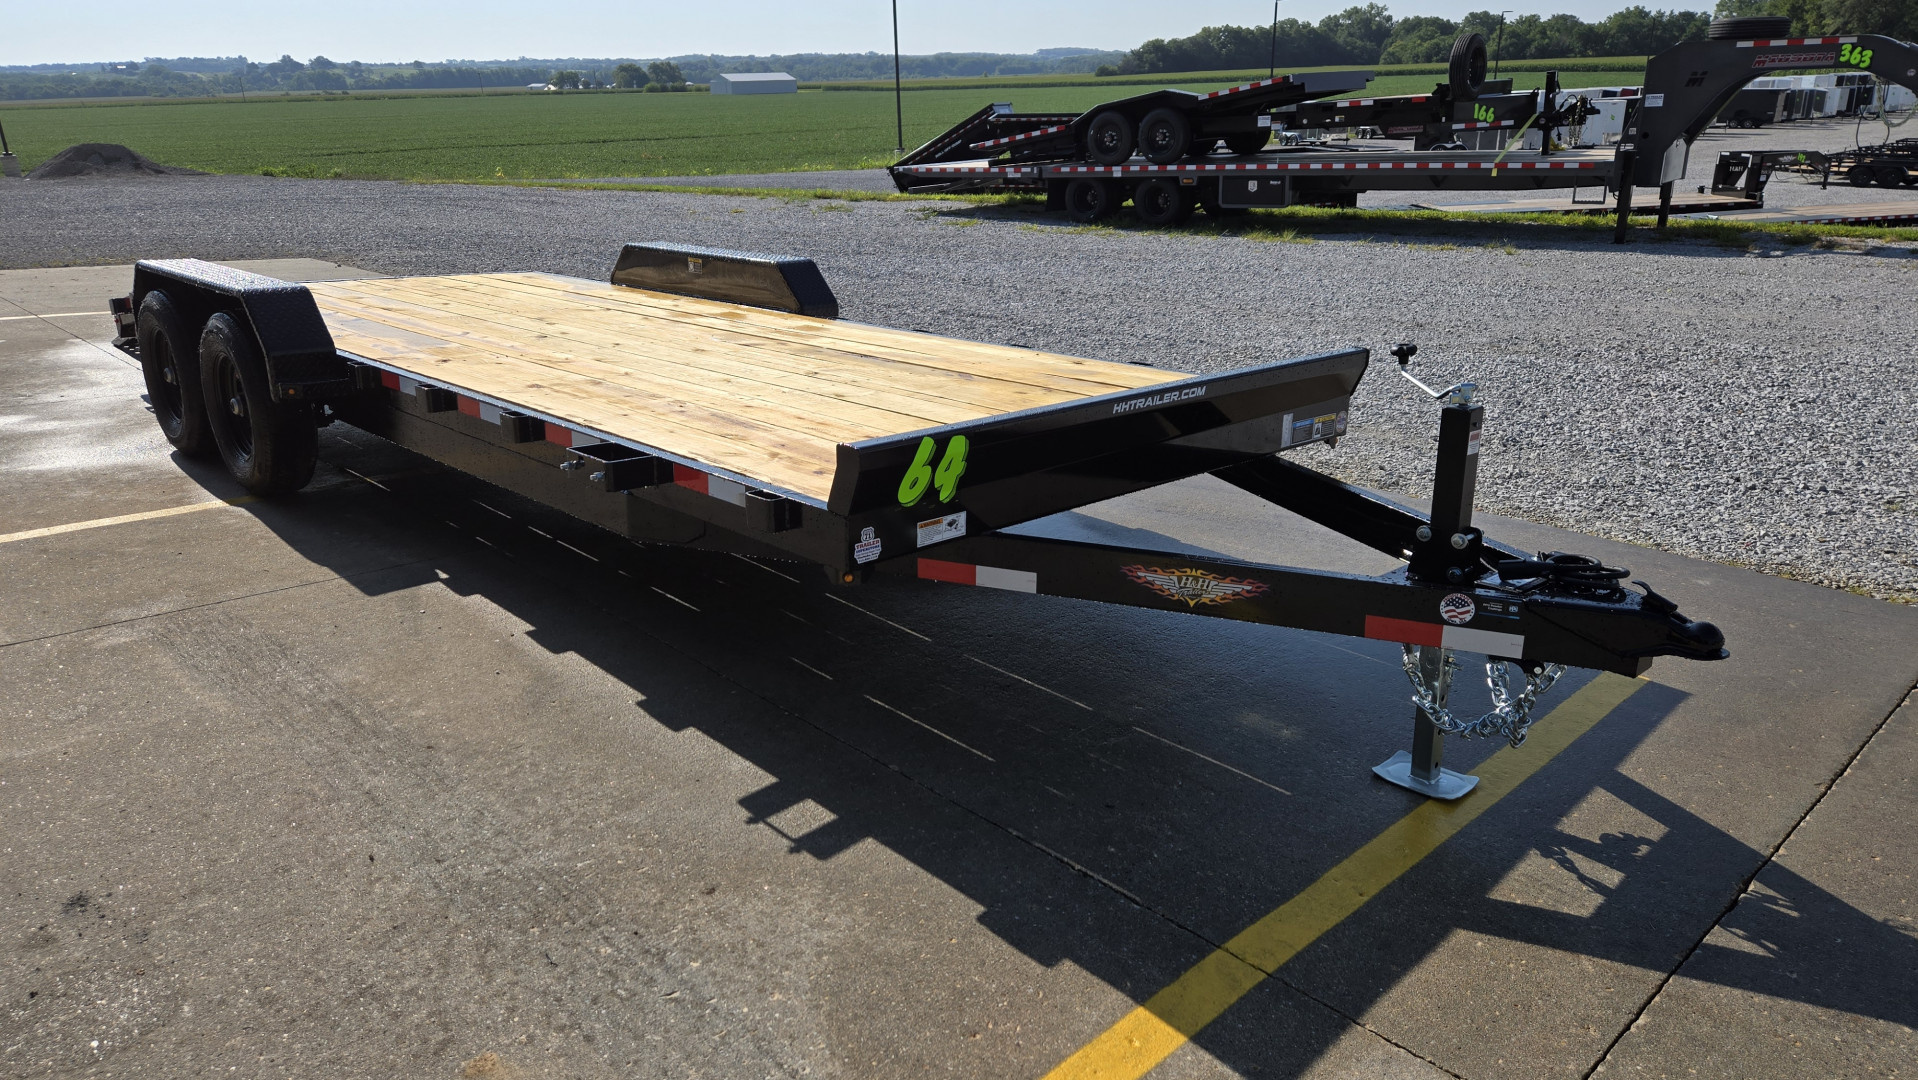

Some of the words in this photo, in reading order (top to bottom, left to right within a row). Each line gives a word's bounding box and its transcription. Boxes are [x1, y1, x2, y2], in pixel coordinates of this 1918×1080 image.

[1839, 43, 1873, 68] 363
[1473, 103, 1495, 123] 166
[1112, 385, 1207, 414] HHTRAILER.COM
[897, 434, 970, 507] 64
[1180, 576, 1210, 589] H&H
